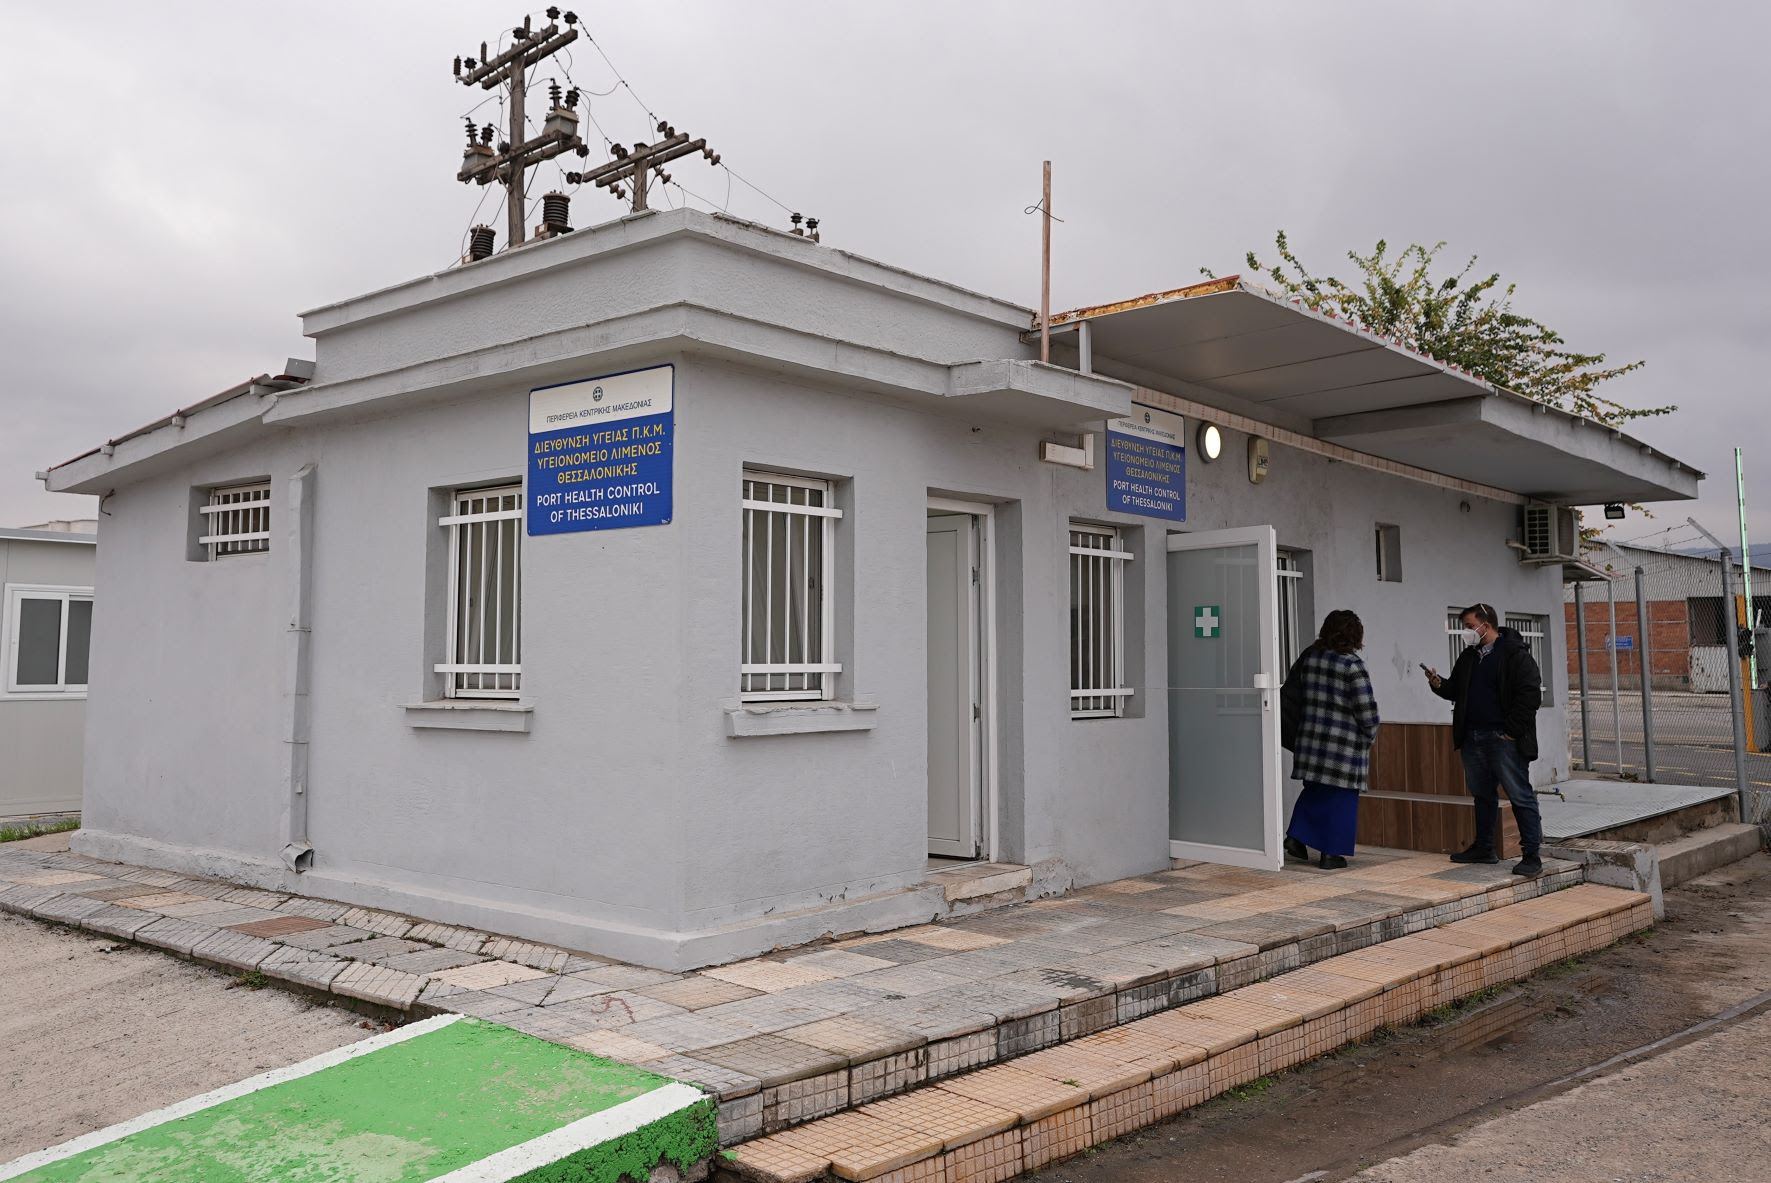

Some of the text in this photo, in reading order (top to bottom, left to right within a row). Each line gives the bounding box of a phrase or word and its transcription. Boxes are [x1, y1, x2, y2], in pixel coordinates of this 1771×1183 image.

[547, 399, 652, 423] ΠΕΡΙΦΕΡΕΙΑ ΚΕΝΤΡΙΚΗΣ ΜΑΚΕΔΟΝΙΑΣ
[534, 424, 665, 453] ΔΙΕΥΘΥΝΣΗ ΥΓΕΙΑΣ Π.Κ.Μ.
[1112, 439, 1144, 451] ΔΙΕΥΘΥΝΣΗ
[1146, 445, 1165, 457] ΥΓΕΙΑΣ
[538, 442, 661, 469] ΥΓΕΙΟΝΟΜΕΙΟ ΛΙΜΕΝΟΣ
[1114, 452, 1180, 473] ΥΓΕΙΟΝΟΜΕΙΟ ΛΙΜΕΝΟΣ
[558, 463, 637, 484] ΘΕΣΣΑΛΟΝΙΚΗΣ
[1126, 467, 1170, 483] ΘΕΣΣΑΛΟΝΙΚΗΣ
[537, 482, 660, 506] PORT HEALTH CONTROL
[1114, 480, 1180, 500] PORT HEALTH CONTROL
[550, 502, 643, 522] OF THESSALONIKI
[1122, 496, 1172, 511] OF THESSALONIKI
